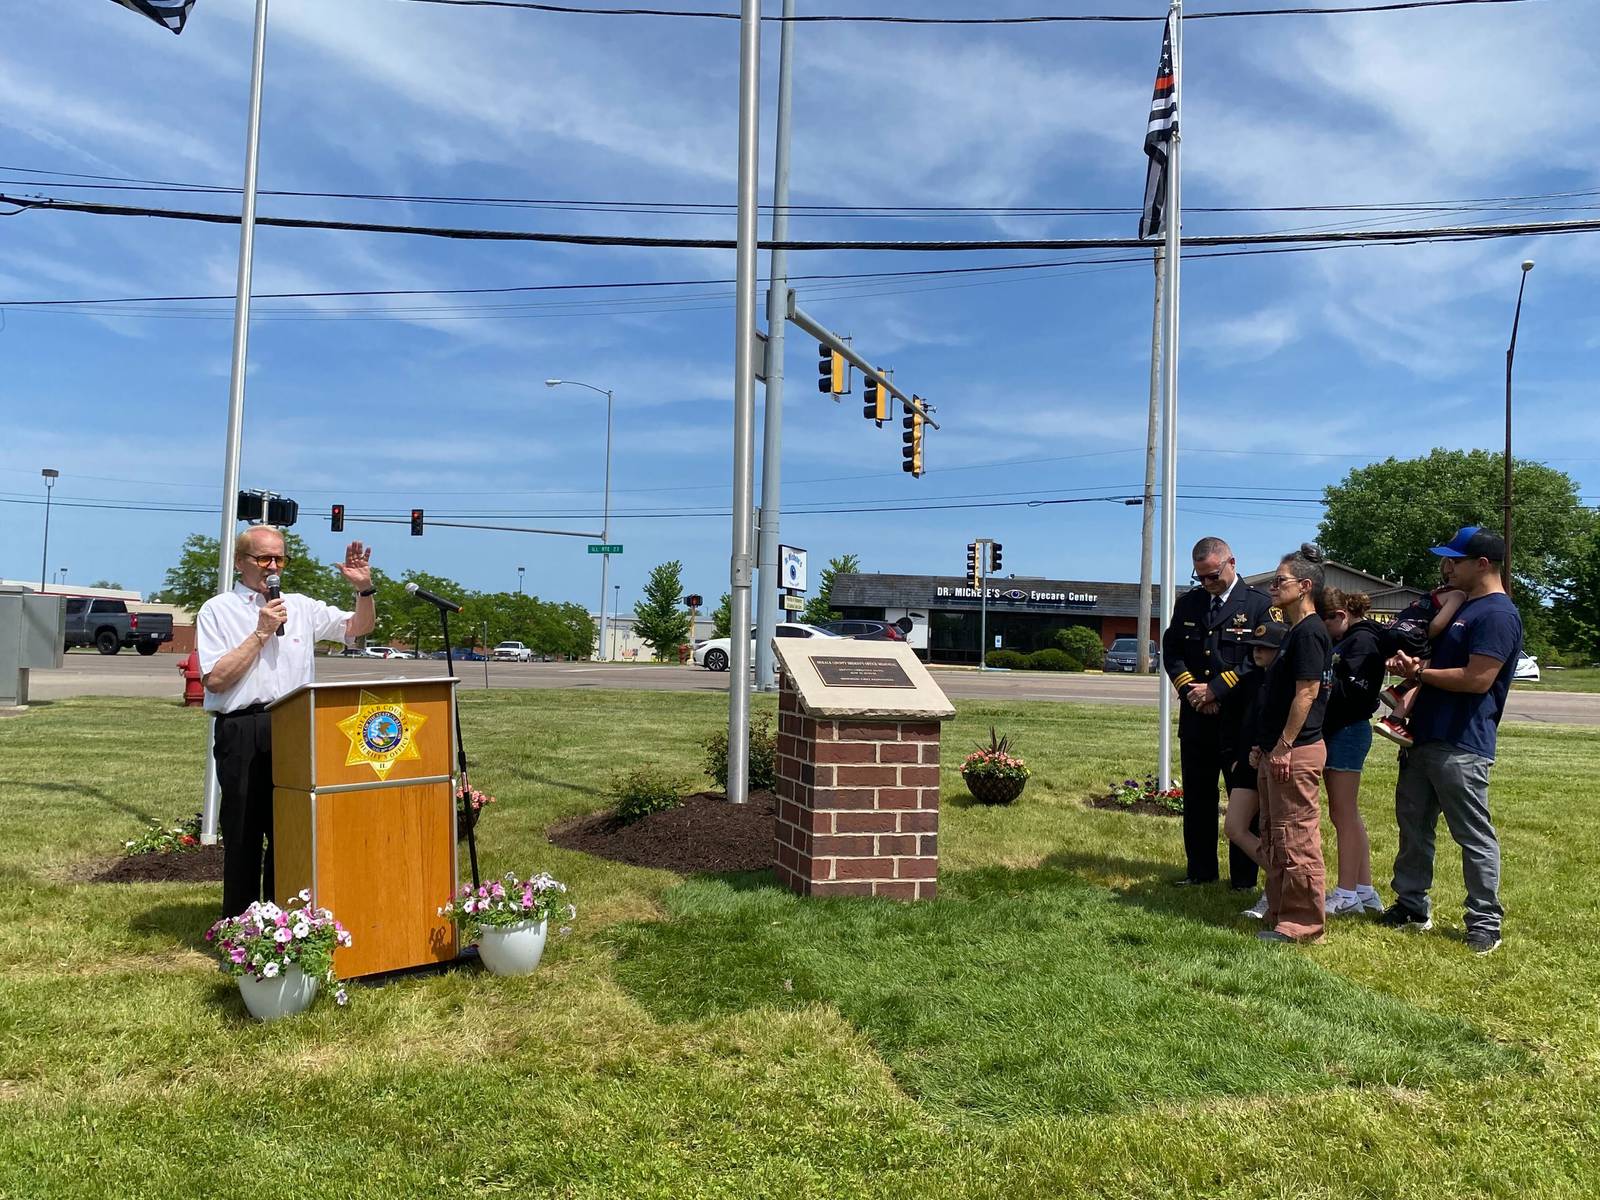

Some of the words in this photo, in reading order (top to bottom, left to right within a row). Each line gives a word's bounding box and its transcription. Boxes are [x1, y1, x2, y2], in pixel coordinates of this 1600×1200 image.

[937, 587, 952, 596] DR.
[1031, 590, 1065, 601] Eyecare
[1068, 593, 1098, 602] Center
